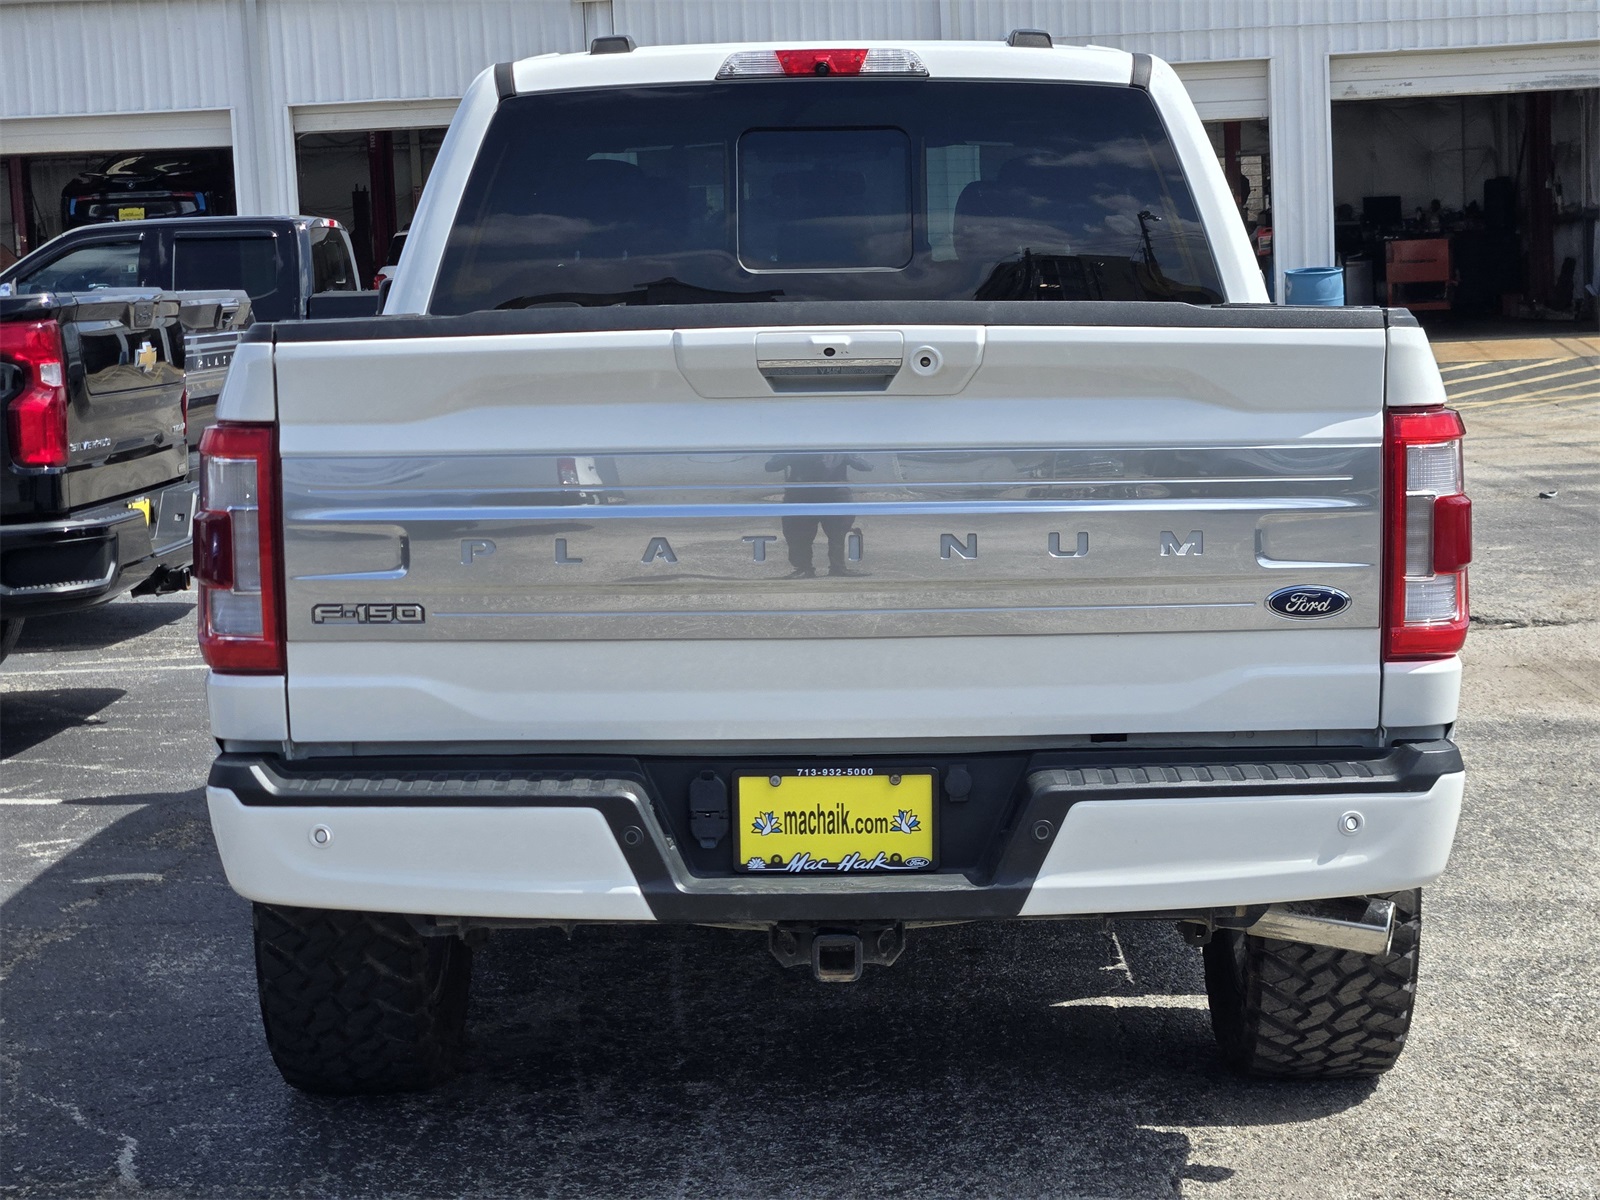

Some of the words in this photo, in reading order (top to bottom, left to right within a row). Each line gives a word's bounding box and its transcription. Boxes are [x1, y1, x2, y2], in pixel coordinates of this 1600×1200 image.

[459, 529, 1204, 566] PLATINUM
[1285, 592, 1333, 612] Ford
[311, 603, 426, 624] F-150
[797, 767, 875, 777] 713-932-5000
[783, 802, 889, 835] machaik.com
[786, 852, 829, 873] Mac
[836, 851, 889, 872] Haik
